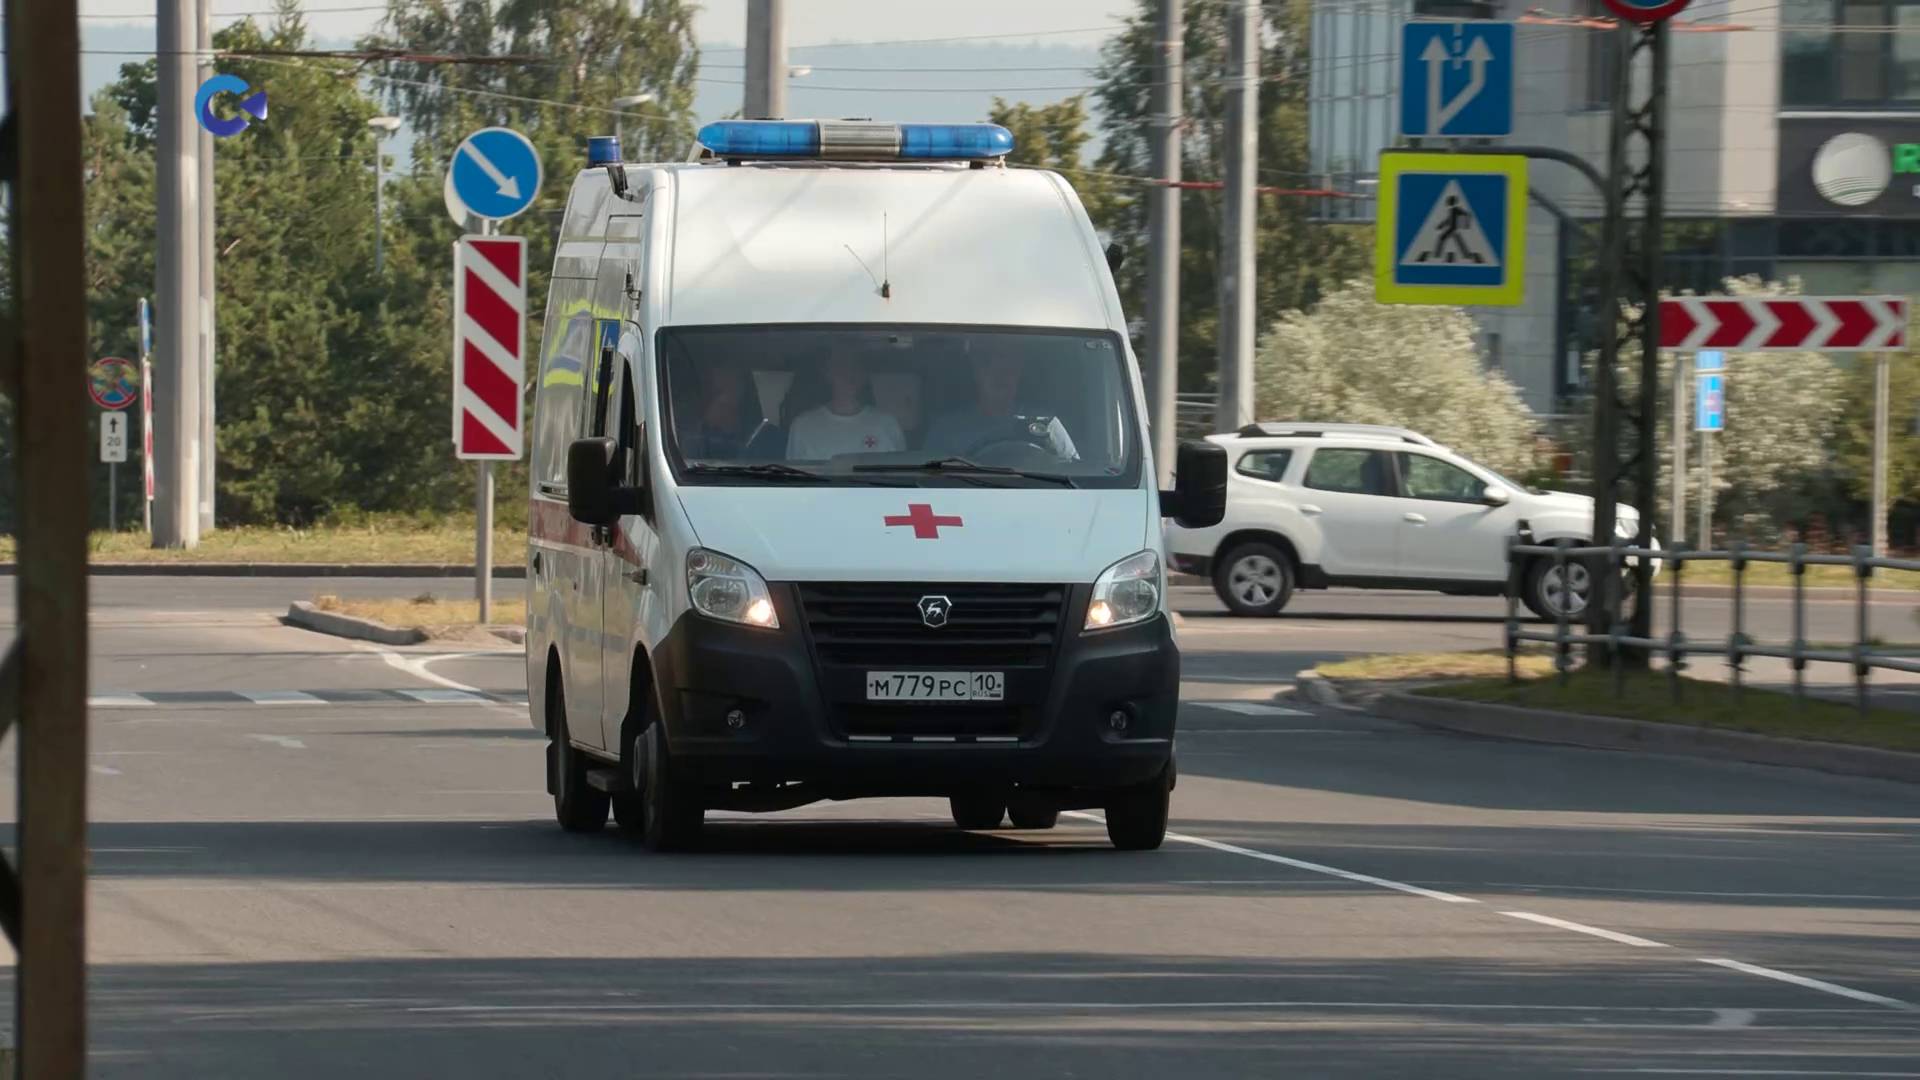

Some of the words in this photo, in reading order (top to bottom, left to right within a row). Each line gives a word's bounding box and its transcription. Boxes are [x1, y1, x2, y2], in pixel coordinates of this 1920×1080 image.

[106, 436, 121, 447] 20
[875, 675, 966, 696] М779РС
[975, 674, 995, 691] 10
